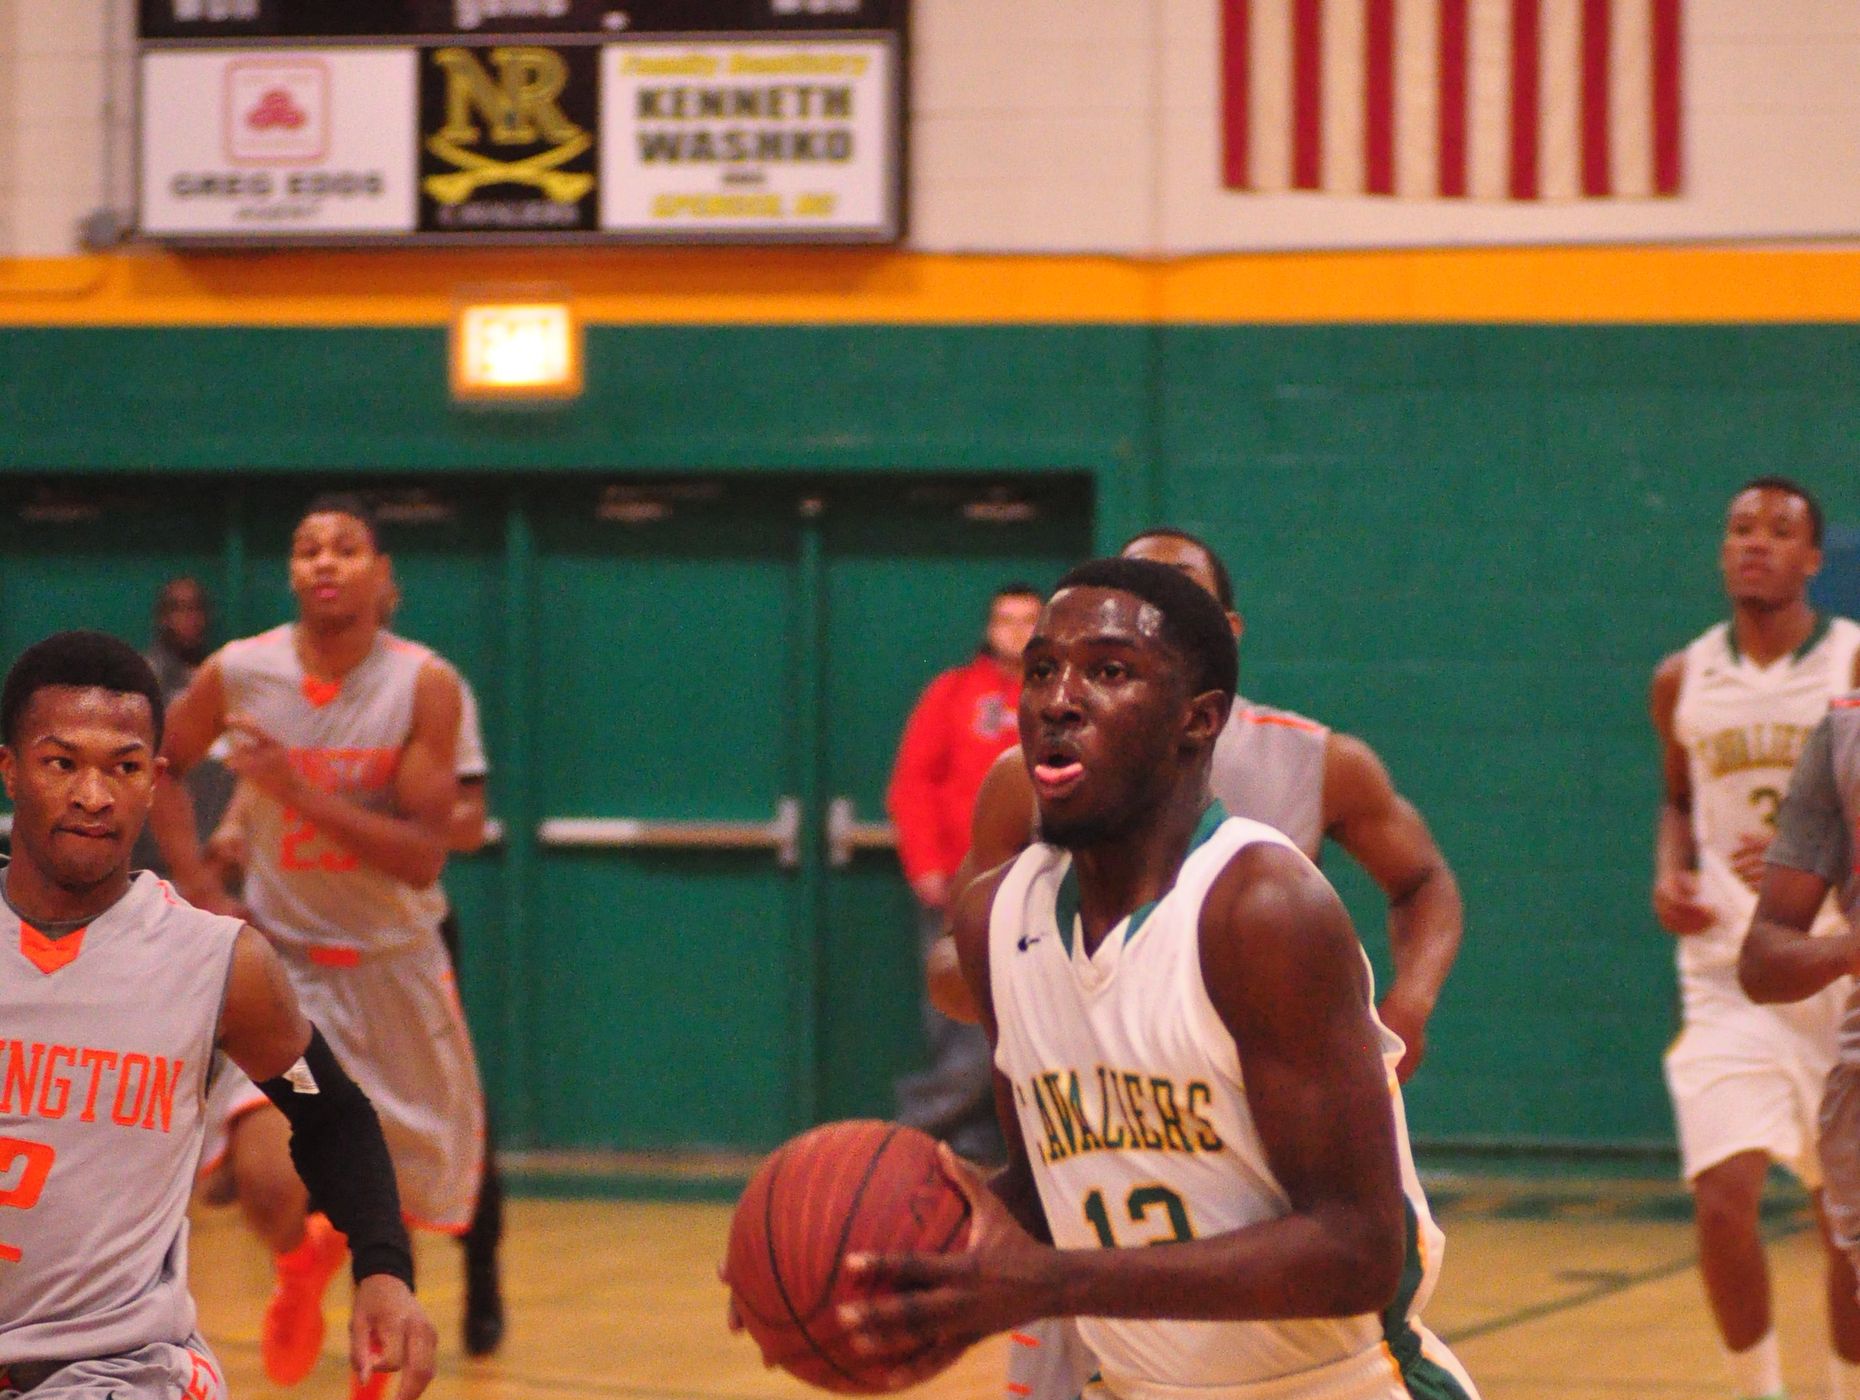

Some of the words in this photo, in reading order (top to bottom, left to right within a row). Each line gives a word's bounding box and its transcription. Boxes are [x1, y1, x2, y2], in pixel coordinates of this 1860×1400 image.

[637, 86, 852, 120] KENNETH
[637, 129, 853, 163] WASHKO
[0, 1039, 185, 1133] NGTON
[1015, 1063, 1224, 1168] AVALIERS
